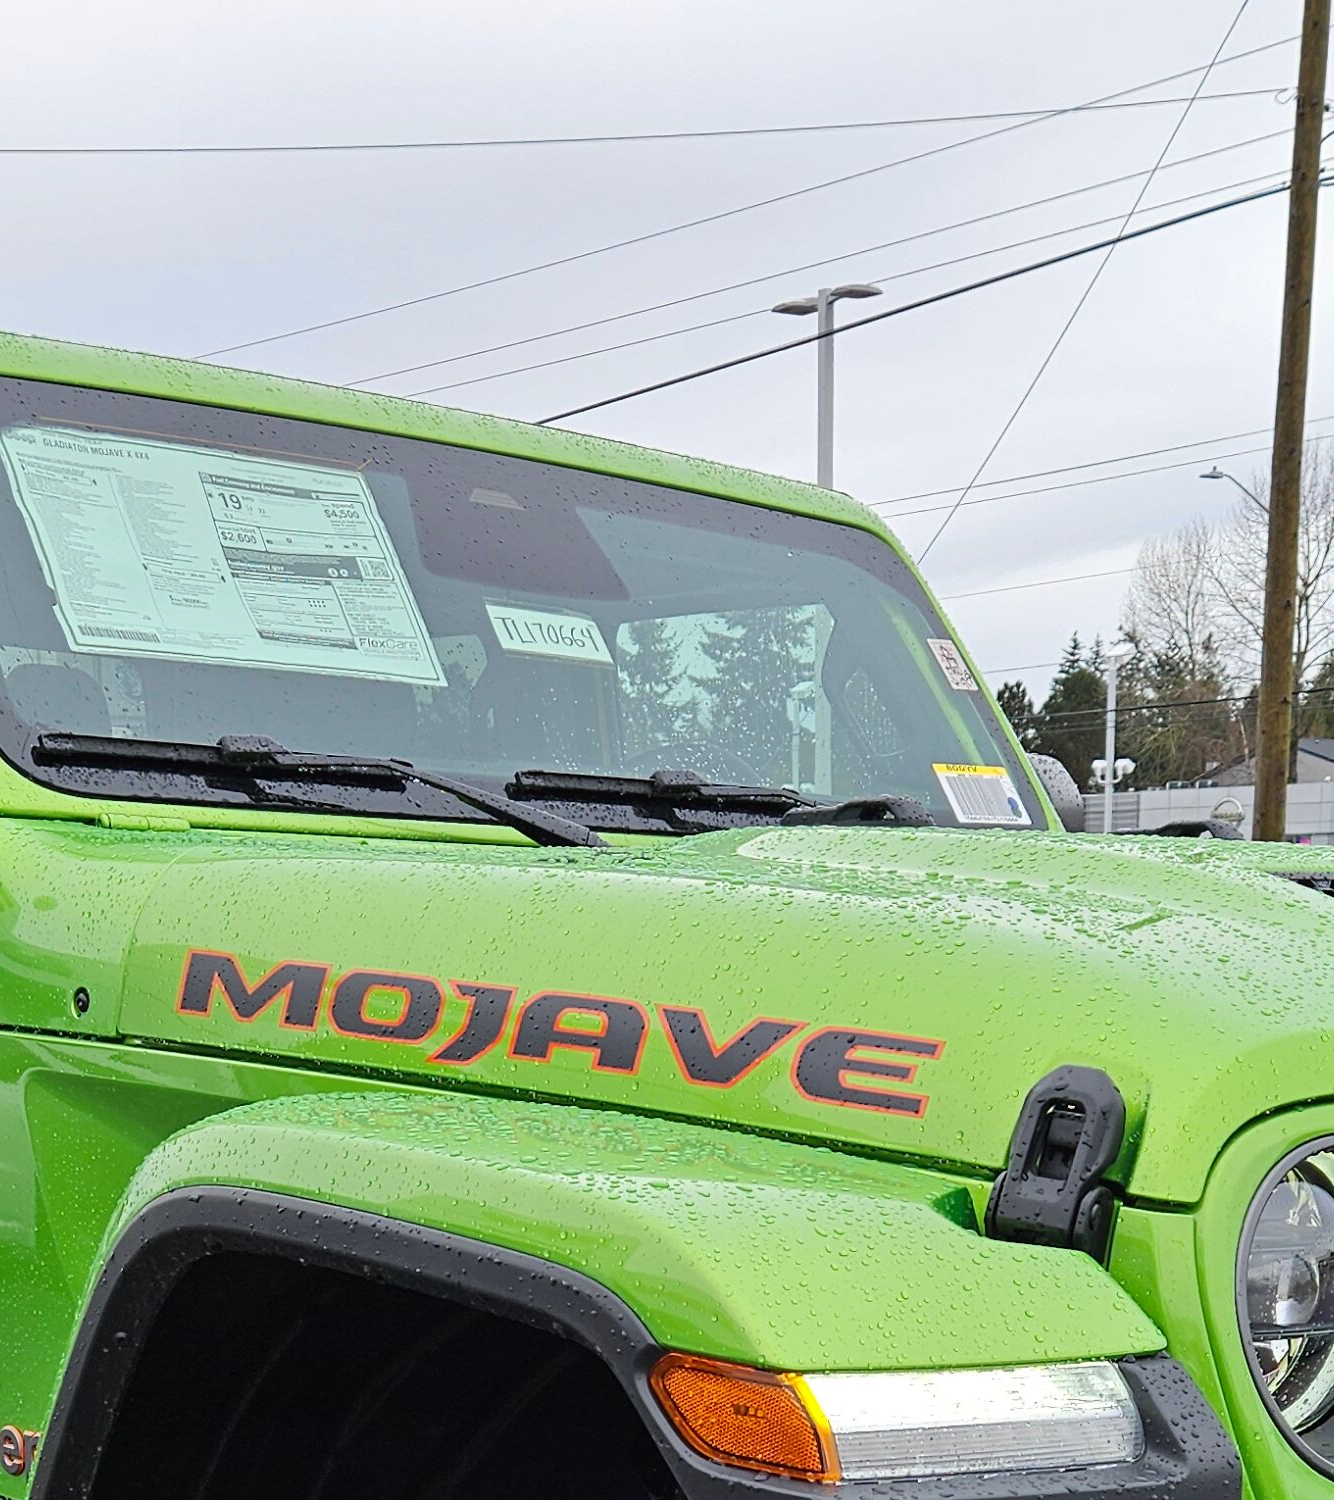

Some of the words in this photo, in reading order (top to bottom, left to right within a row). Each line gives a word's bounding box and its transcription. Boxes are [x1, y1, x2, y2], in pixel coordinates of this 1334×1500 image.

[42, 437, 89, 455] GLADIATOR
[90, 448, 124, 459] MOJAVE
[218, 492, 242, 510] 19
[323, 509, 360, 520] $4,500
[220, 530, 257, 545] $2,600
[357, 637, 418, 652] FlexCare
[175, 948, 945, 1119] MOJAVE
